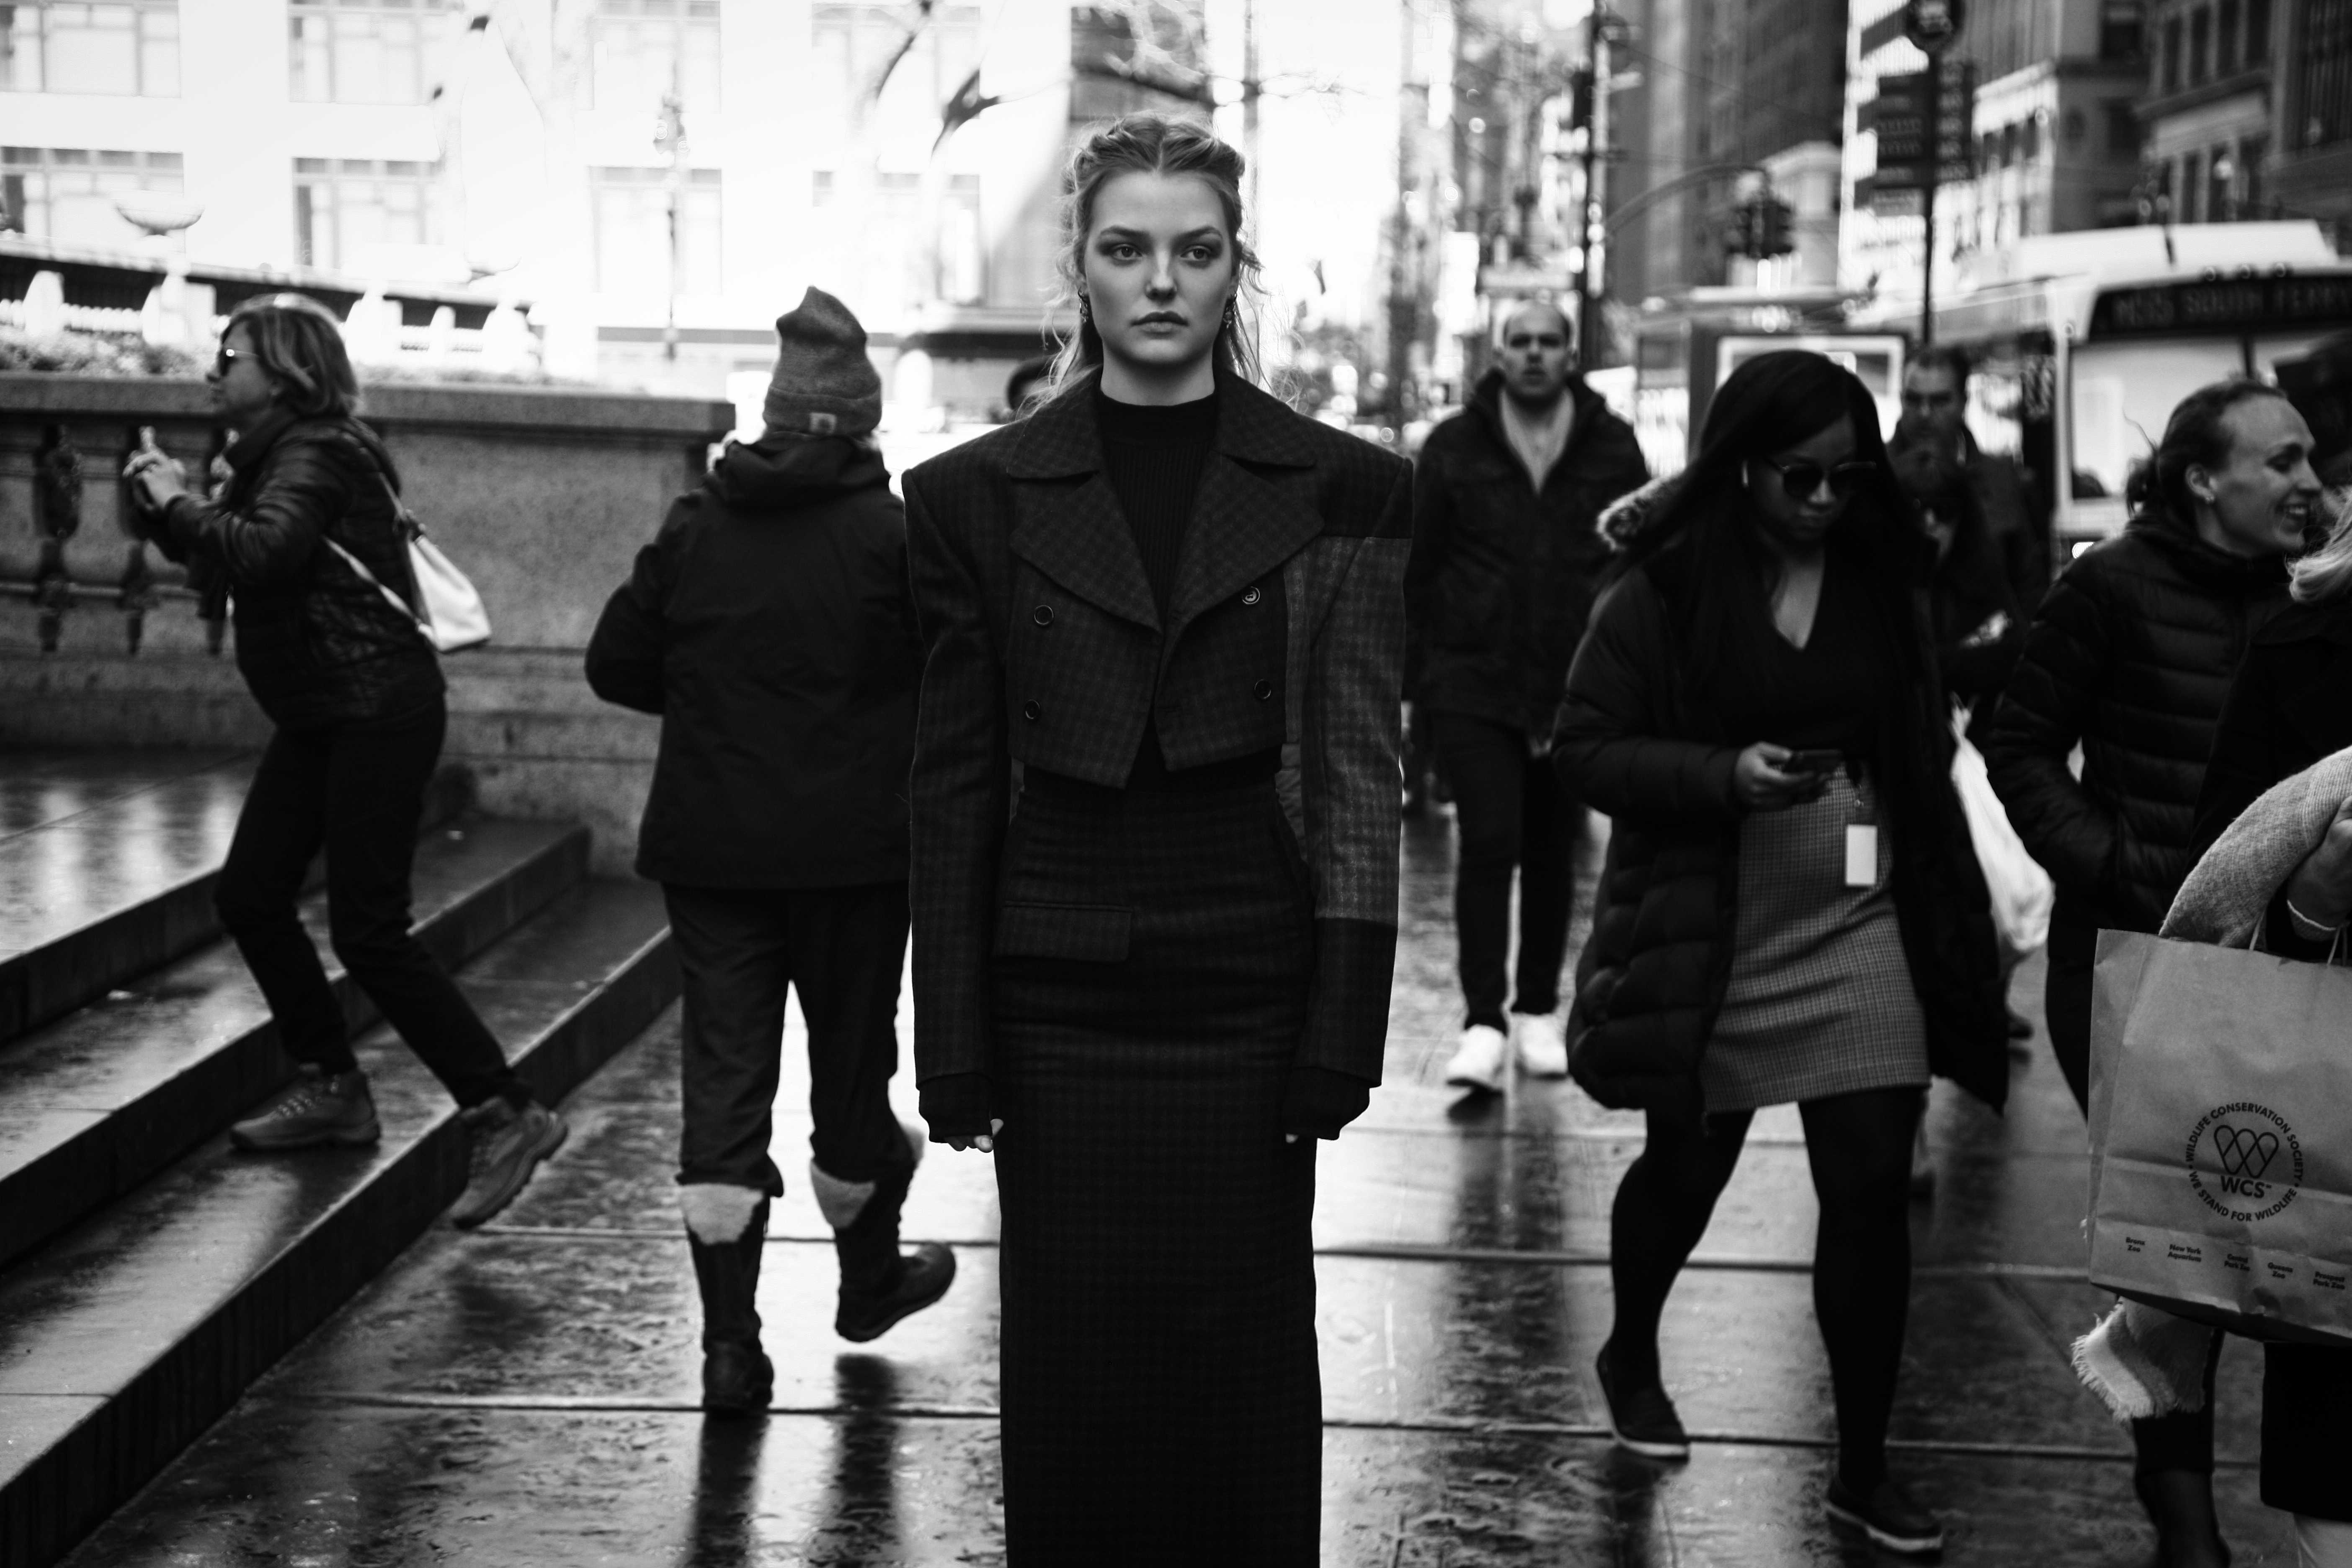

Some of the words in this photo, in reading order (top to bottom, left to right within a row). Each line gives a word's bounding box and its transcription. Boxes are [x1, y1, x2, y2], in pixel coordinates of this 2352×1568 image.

[2181, 287, 2263, 321] SOUTH
[2186, 1117, 2211, 1162] WILDLIFE
[2210, 1102, 2291, 1134] CONSERVATION
[2287, 1134, 2303, 1181] SOCIETY
[2189, 1171, 2202, 1189] WE
[2198, 1189, 2229, 1217] STAND
[2231, 1211, 2252, 1222] FOR
[2255, 1188, 2297, 1220] WILDLIFE
[2126, 1237, 2145, 1246] Bronx
[2168, 1251, 2202, 1262] Aquarium
[2227, 1253, 2248, 1264] Central
[2267, 1262, 2293, 1273] Queens
[2315, 1271, 2345, 1282] Prospect
[2313, 1279, 2329, 1287] Park
